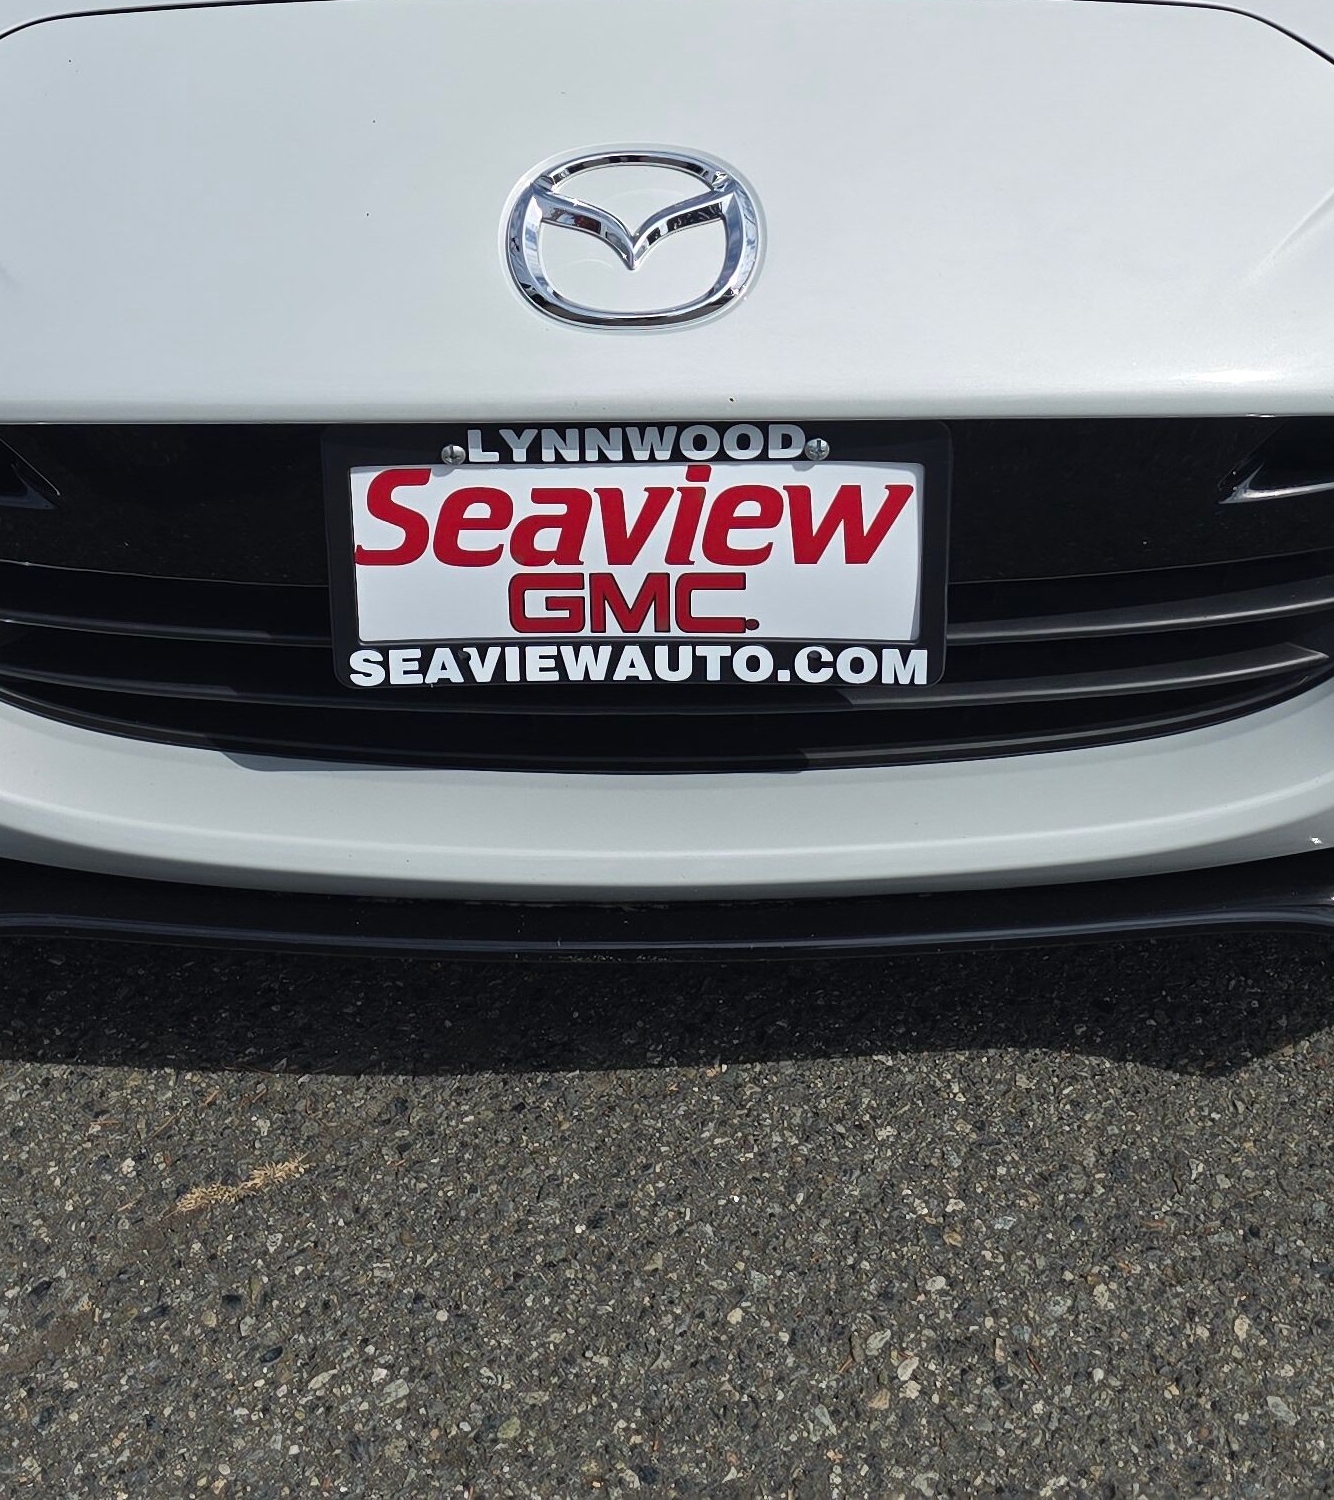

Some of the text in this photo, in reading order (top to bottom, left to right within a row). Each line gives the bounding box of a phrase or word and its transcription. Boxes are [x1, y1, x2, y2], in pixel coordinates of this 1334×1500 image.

[467, 424, 806, 463] LYNNWOOD
[354, 464, 913, 567] Seaview
[350, 646, 928, 686] SEAVIEWAUTO.COM
